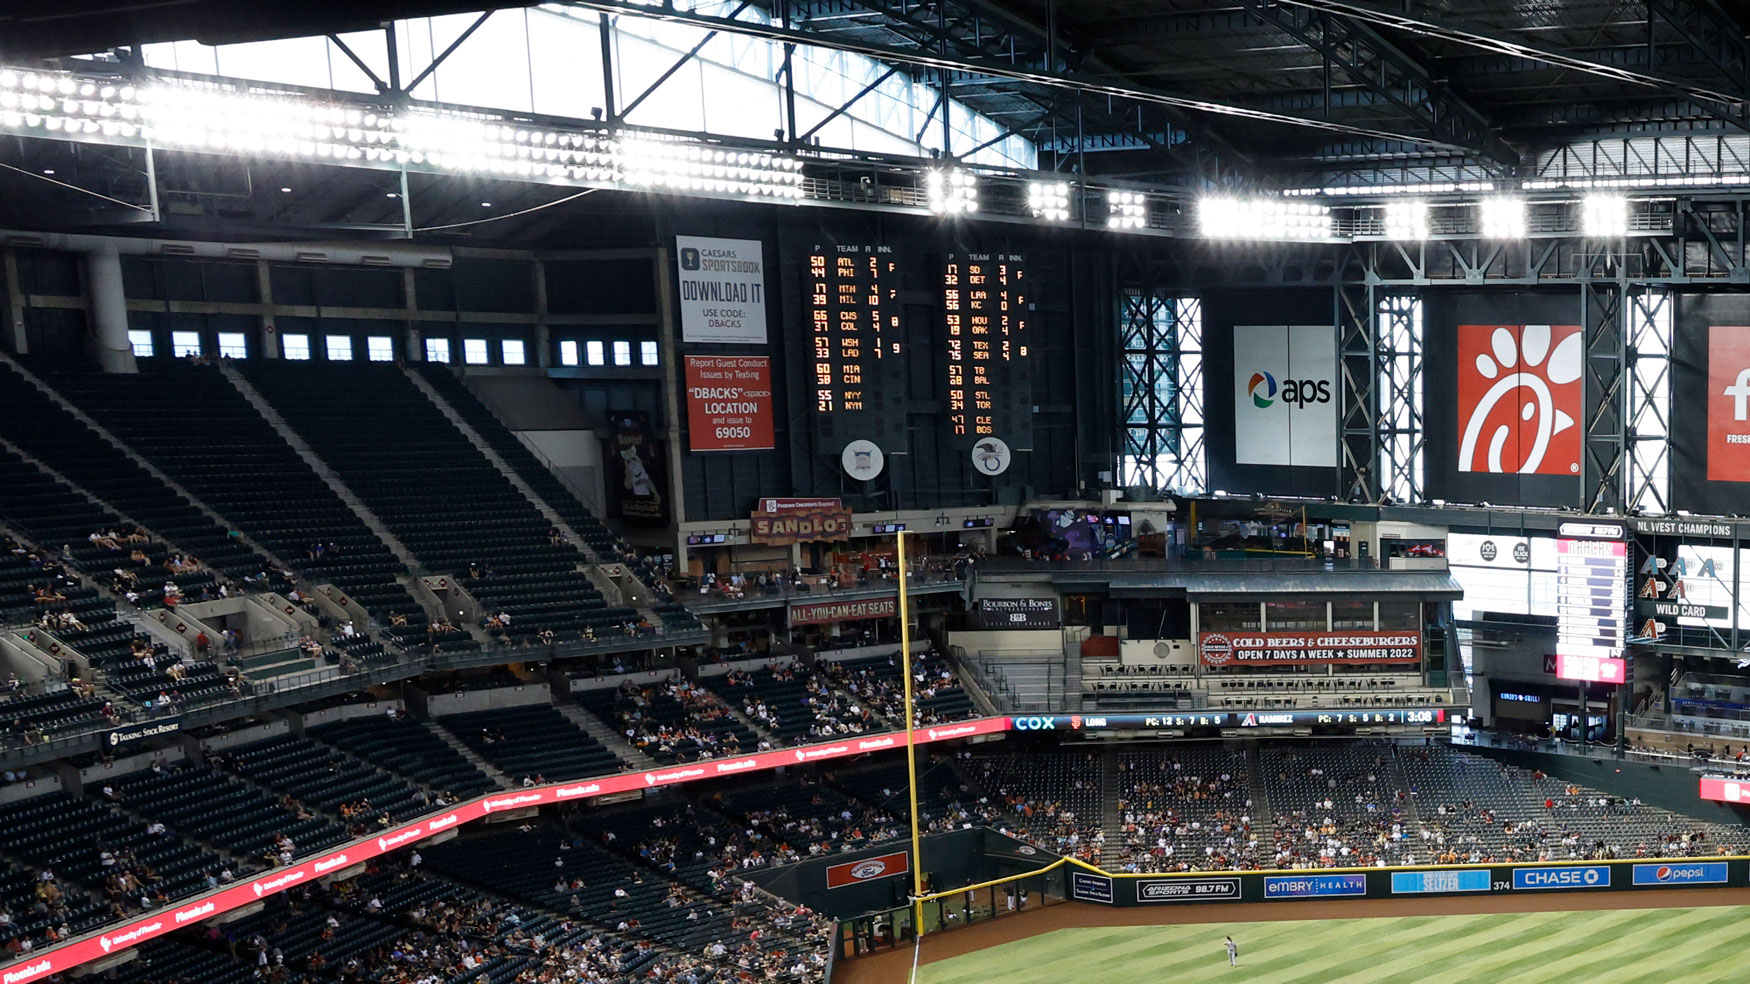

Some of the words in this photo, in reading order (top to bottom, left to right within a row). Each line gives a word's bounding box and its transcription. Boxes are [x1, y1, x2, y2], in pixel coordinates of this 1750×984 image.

[701, 249, 736, 258] CAESARS
[837, 257, 854, 266] ATL
[702, 259, 760, 274] SPORTSBOOK
[969, 265, 980, 274] SD
[838, 268, 854, 277] PHI
[970, 276, 986, 284] DET
[682, 280, 747, 302] DOWNLOAD
[751, 283, 761, 304] IT
[970, 291, 986, 300] LAA
[839, 295, 856, 304] MIL
[970, 301, 982, 310] KC
[702, 309, 718, 317] USE
[720, 310, 746, 318] CODE:
[840, 312, 858, 320] CWS
[708, 320, 742, 328] DBACKS
[972, 316, 988, 324] HOU
[840, 322, 858, 330] COL
[972, 326, 988, 334] OAK
[841, 338, 858, 346] WSH
[973, 341, 989, 350] TEX
[842, 349, 859, 357] LAD
[973, 351, 989, 360] SEA
[690, 358, 714, 368] Report
[716, 359, 736, 368] Guest
[738, 360, 767, 368] Conduct
[843, 365, 860, 374] MIA
[974, 366, 984, 374] TB
[700, 370, 722, 378] Issues
[724, 371, 732, 380] by
[734, 370, 760, 380] Texting
[844, 374, 860, 384] CIN
[975, 392, 990, 400] STL
[1282, 379, 1330, 409] aps
[704, 402, 758, 414] LOCATION
[976, 401, 991, 409] TOR
[976, 416, 992, 424] CLE
[716, 427, 750, 438] 69050
[976, 426, 992, 434] BOS
[1638, 522, 1648, 532] NL
[1651, 522, 1676, 533] WEST
[1678, 523, 1730, 535] CHAMPIONS
[983, 599, 1018, 608] BOURBON
[1028, 599, 1052, 608] BONES
[791, 603, 866, 622] ALL-YOU-CAN-EAT
[868, 600, 894, 614] SEATS
[1656, 604, 1678, 616] WILD
[1682, 606, 1706, 617] CARD
[1233, 638, 1264, 647] COLD
[1267, 638, 1305, 647] BEERS
[1308, 638, 1314, 646] &
[1317, 636, 1418, 646] CHEESEBURGERS
[1238, 650, 1264, 660] OPEN
[1266, 650, 1271, 660] 7
[1273, 650, 1298, 660] DAYS
[1308, 649, 1334, 659] WEEK
[1347, 648, 1388, 658] SUMMER
[1390, 648, 1414, 658] 2022
[1258, 714, 1294, 724] RAMIREZ
[1408, 711, 1432, 722] 3:08
[1016, 716, 1055, 730] COX
[1085, 718, 1106, 726] LONG
[1524, 871, 1582, 884] CHASE
[1672, 867, 1704, 881] pepsi
[1195, 884, 1214, 893] 98.7
[1216, 884, 1229, 893] FM
[1319, 880, 1363, 890] HEALTH
[1423, 877, 1459, 892] SELTZER
[1493, 881, 1510, 891] 374
[176, 902, 214, 922] Phoenix.edu
[4, 959, 52, 984] Phoenix.edu
